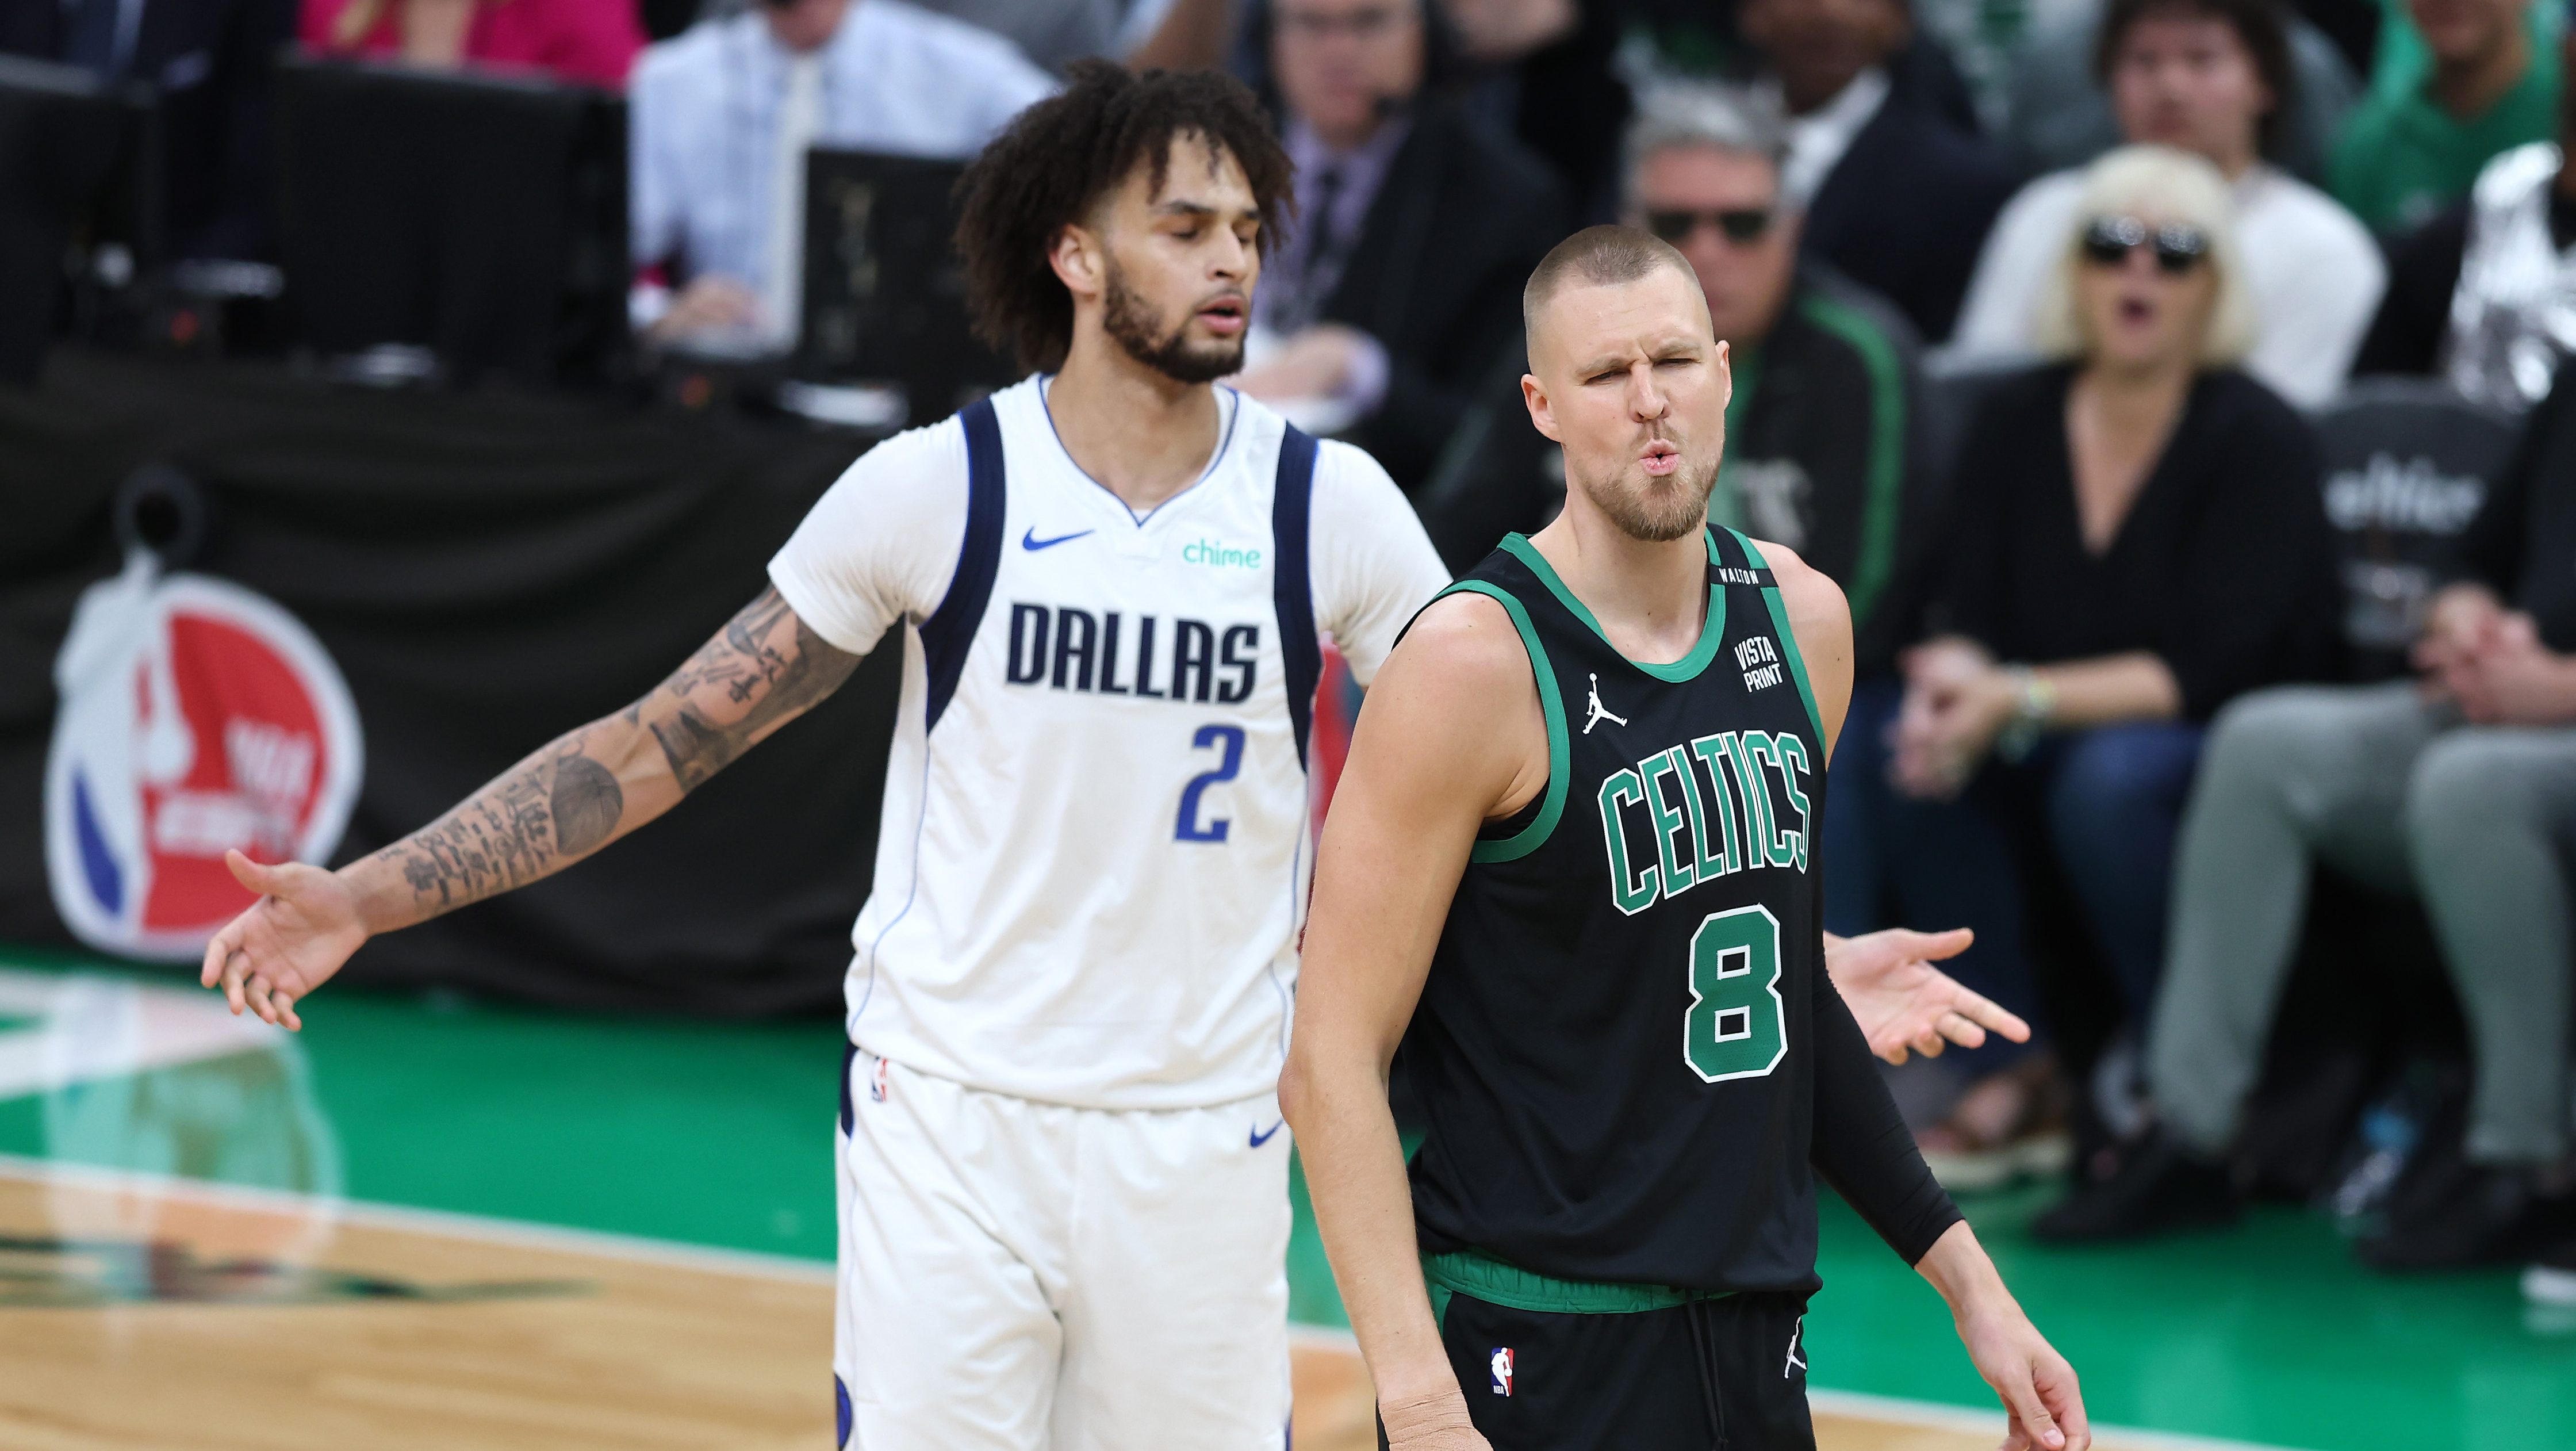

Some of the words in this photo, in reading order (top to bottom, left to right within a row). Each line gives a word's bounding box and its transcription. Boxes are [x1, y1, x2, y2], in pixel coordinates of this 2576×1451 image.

[1183, 538, 1261, 569] chime
[1719, 568, 1759, 585] WALTON
[1006, 602, 1259, 705] DALLAS
[1734, 636, 1778, 671] VISTA
[1743, 663, 1783, 693] PRINT
[1175, 724, 1246, 842] 2
[1597, 730, 1811, 916] CELTICS
[1683, 903, 1789, 1084] 8
[1493, 1385, 1504, 1394] NBA
